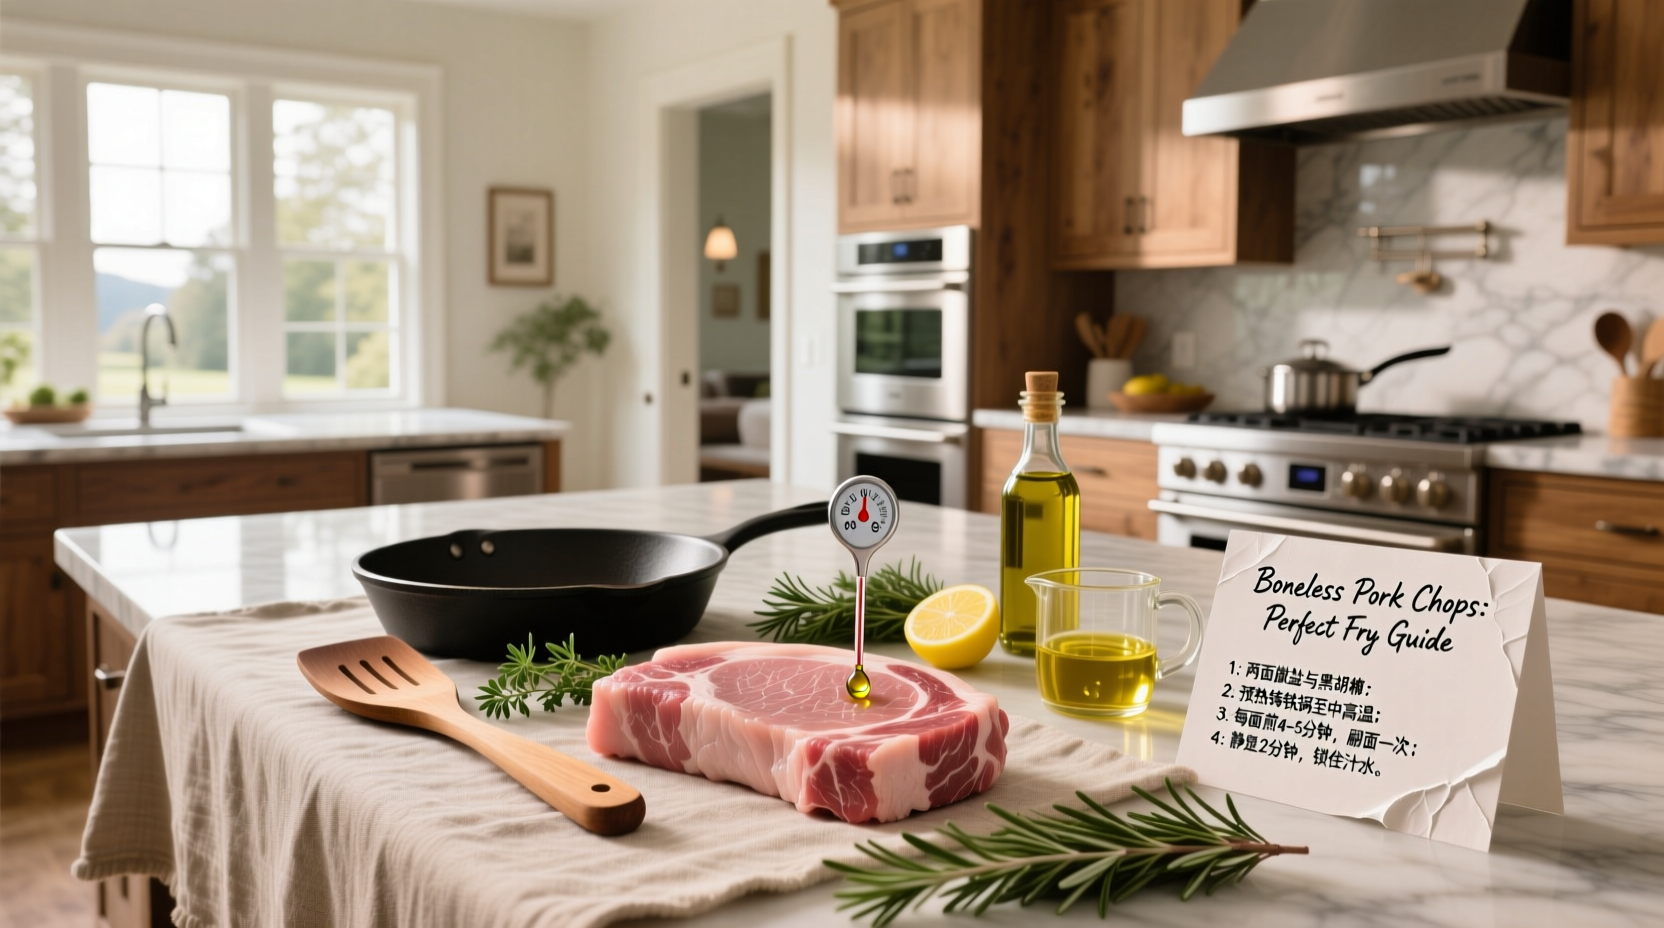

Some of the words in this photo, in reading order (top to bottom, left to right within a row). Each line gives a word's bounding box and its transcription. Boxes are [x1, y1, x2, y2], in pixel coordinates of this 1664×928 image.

[1253, 566, 1345, 602] Boneless
[1352, 577, 1405, 609] Pork
[1411, 584, 1490, 625] Chops:
[1263, 603, 1340, 646] Perfect
[1342, 615, 1381, 656] Fry
[1387, 619, 1454, 654] Guide
